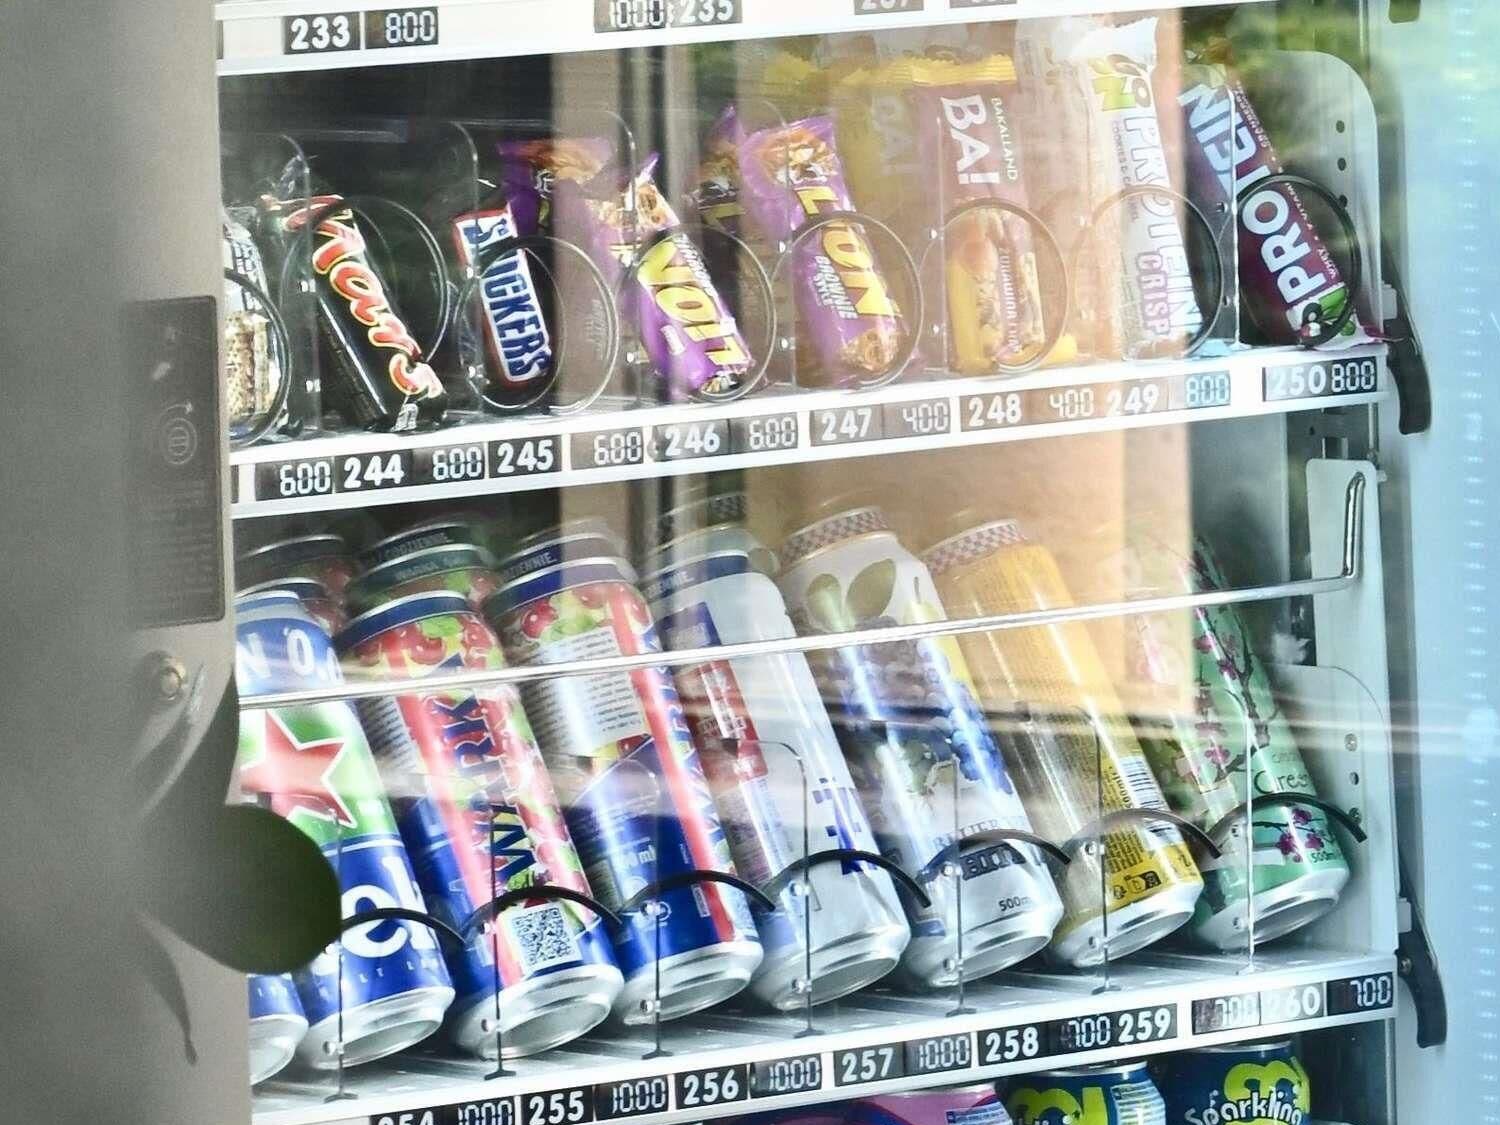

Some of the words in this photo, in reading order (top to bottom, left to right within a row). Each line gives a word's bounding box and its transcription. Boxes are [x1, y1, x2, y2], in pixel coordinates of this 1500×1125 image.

[290, 16, 351, 50] 233
[941, 93, 1000, 186] BA!
[990, 97, 1018, 181] BAKALLAND
[1180, 84, 1325, 313] PROTEIN
[1135, 251, 1172, 336] CRISP
[1274, 365, 1327, 396] 250
[968, 393, 1022, 427] 248
[1106, 384, 1160, 416] 249
[665, 423, 721, 457] 246
[821, 408, 873, 441] 247
[343, 454, 405, 489] 244
[497, 439, 554, 473] 245
[1266, 985, 1322, 1017] 60
[1118, 1008, 1172, 1044] 259
[984, 1026, 1039, 1062] 258
[842, 1047, 893, 1083] 257
[683, 1069, 739, 1105] 256
[529, 1090, 585, 1125] 255
